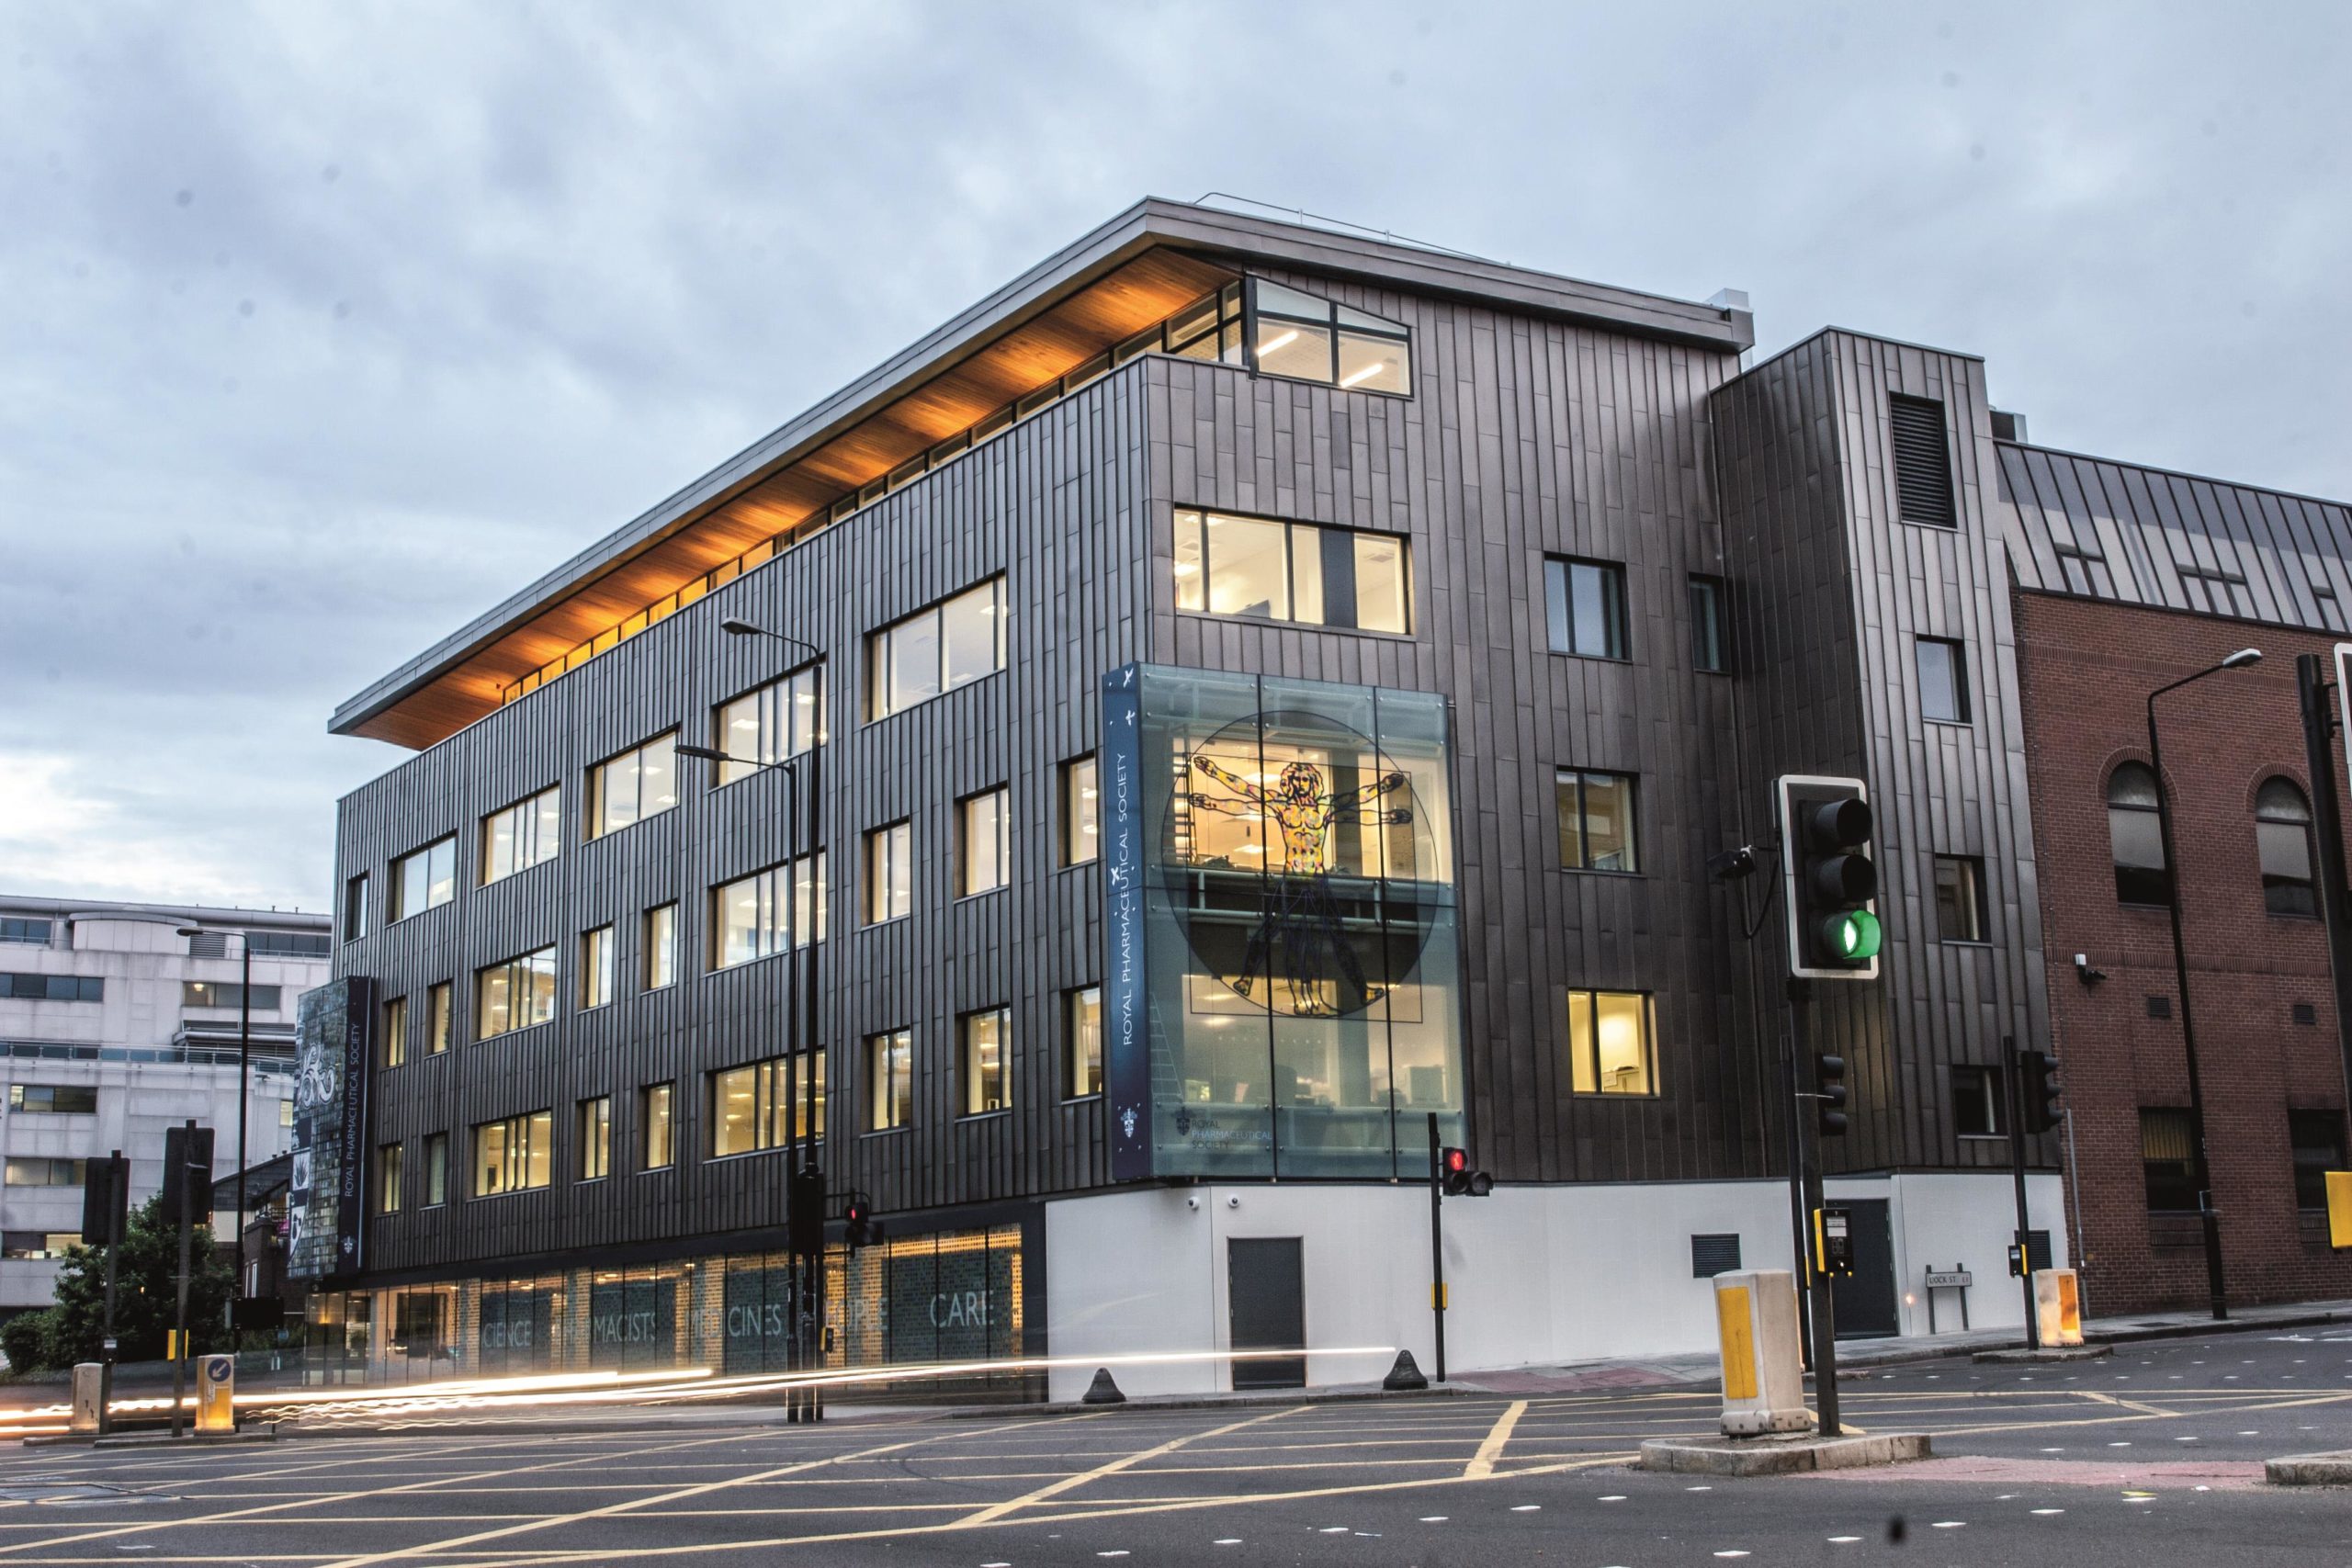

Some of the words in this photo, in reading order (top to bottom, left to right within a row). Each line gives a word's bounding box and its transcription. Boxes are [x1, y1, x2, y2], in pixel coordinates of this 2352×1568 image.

[1117, 752, 1127, 822] SOCIETY
[1118, 828, 1131, 982] PHARMACEUTICAL
[1122, 989, 1133, 1045] ROYAL
[350, 1023, 361, 1066] SOCIETY
[346, 1069, 358, 1160] PHARMACEUTICAL
[1192, 1119, 1221, 1129] ROYAL
[1192, 1130, 1272, 1140] PHARMACEUTICAL
[1192, 1140, 1229, 1150] SOCIETY
[345, 1164, 356, 1197] ROYAL
[482, 1319, 532, 1348] CIENCE
[555, 1312, 656, 1347] HARMACISTS
[825, 1296, 888, 1333] EOPLE
[929, 1290, 994, 1328] CARE
